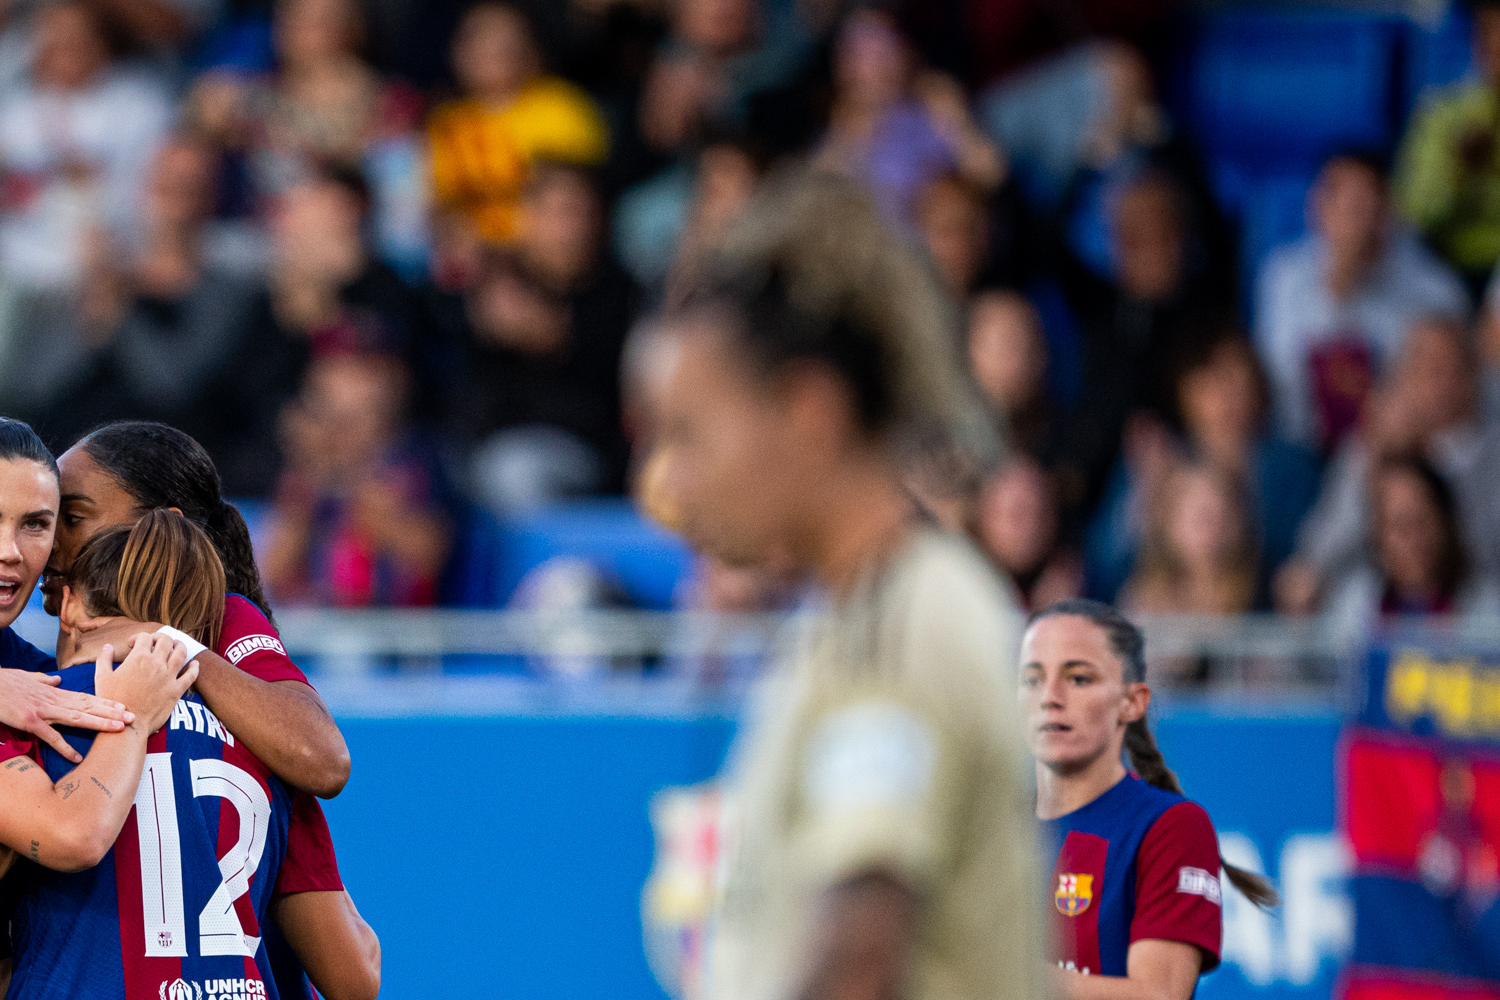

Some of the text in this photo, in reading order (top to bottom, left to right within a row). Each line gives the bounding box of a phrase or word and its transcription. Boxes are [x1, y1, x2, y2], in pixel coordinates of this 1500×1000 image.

[226, 636, 285, 664] BIMBO
[169, 698, 235, 748] ATRI
[133, 751, 273, 959] 12
[204, 978, 266, 995] UNHCR
